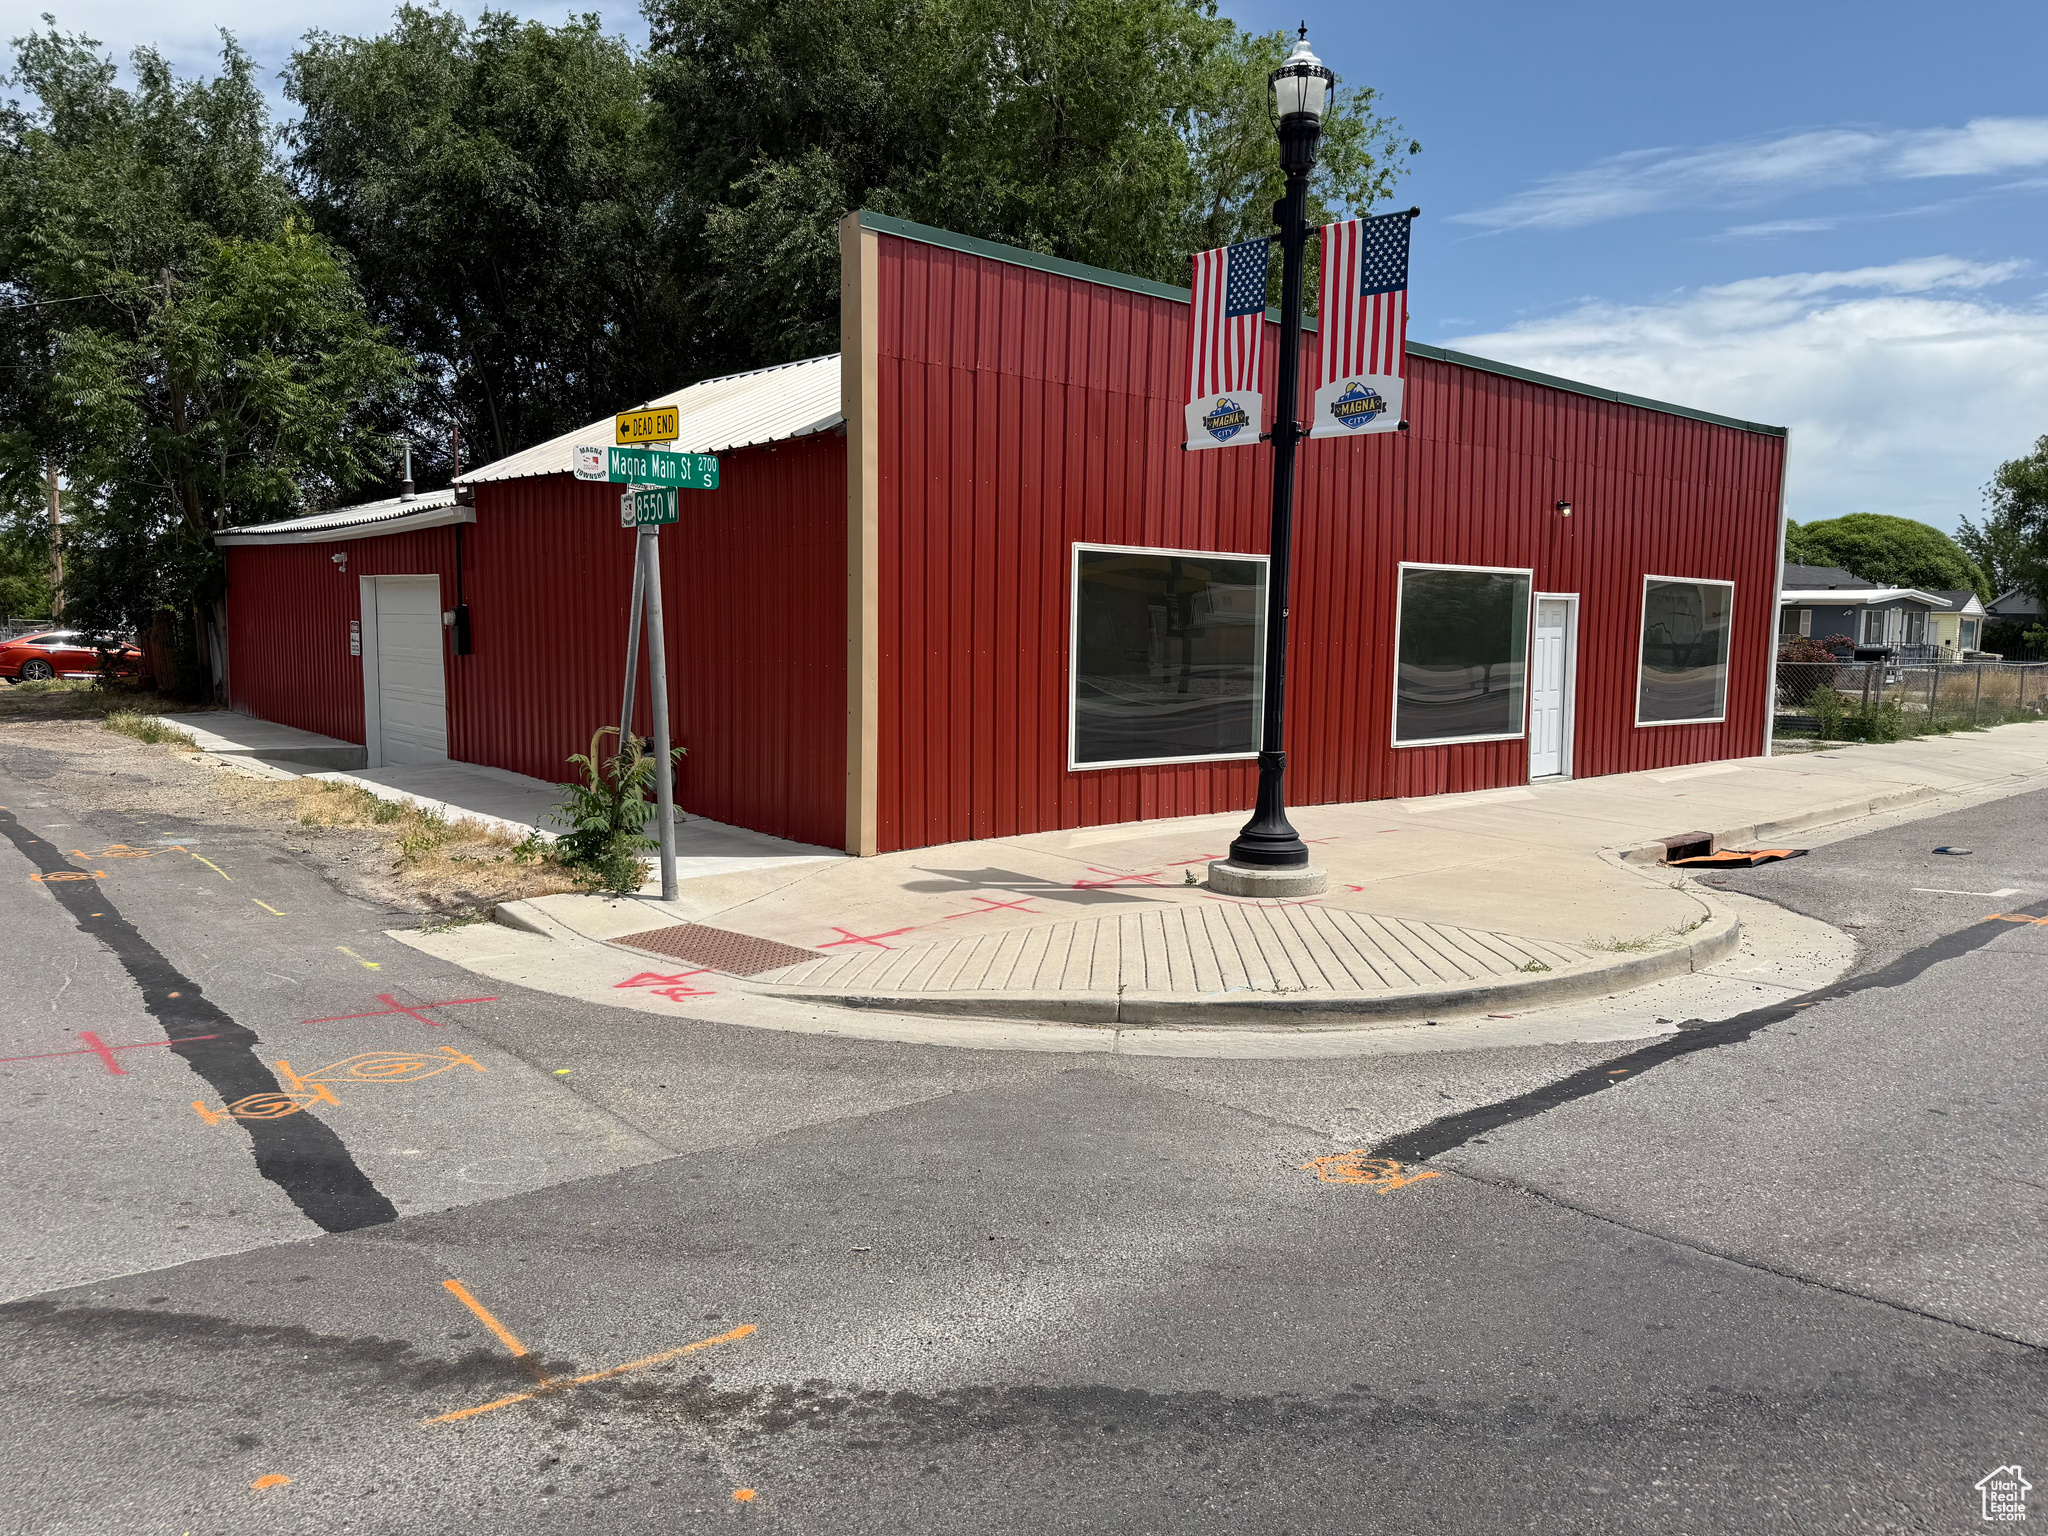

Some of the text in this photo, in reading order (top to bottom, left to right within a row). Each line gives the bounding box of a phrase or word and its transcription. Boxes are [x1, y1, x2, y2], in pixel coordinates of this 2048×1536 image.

[1341, 398, 1376, 416] MAGNA
[633, 414, 674, 437] DEAD END
[1212, 412, 1240, 429] MAGNA
[1348, 416, 1368, 425] CITY
[1217, 428, 1234, 437] CITY
[579, 446, 603, 456] MAGNA
[611, 450, 691, 483] Magna Main St
[698, 456, 717, 472] 2700
[576, 468, 607, 480] TOWNSHIP
[703, 473, 713, 488] S
[636, 491, 676, 522] 8550 W
